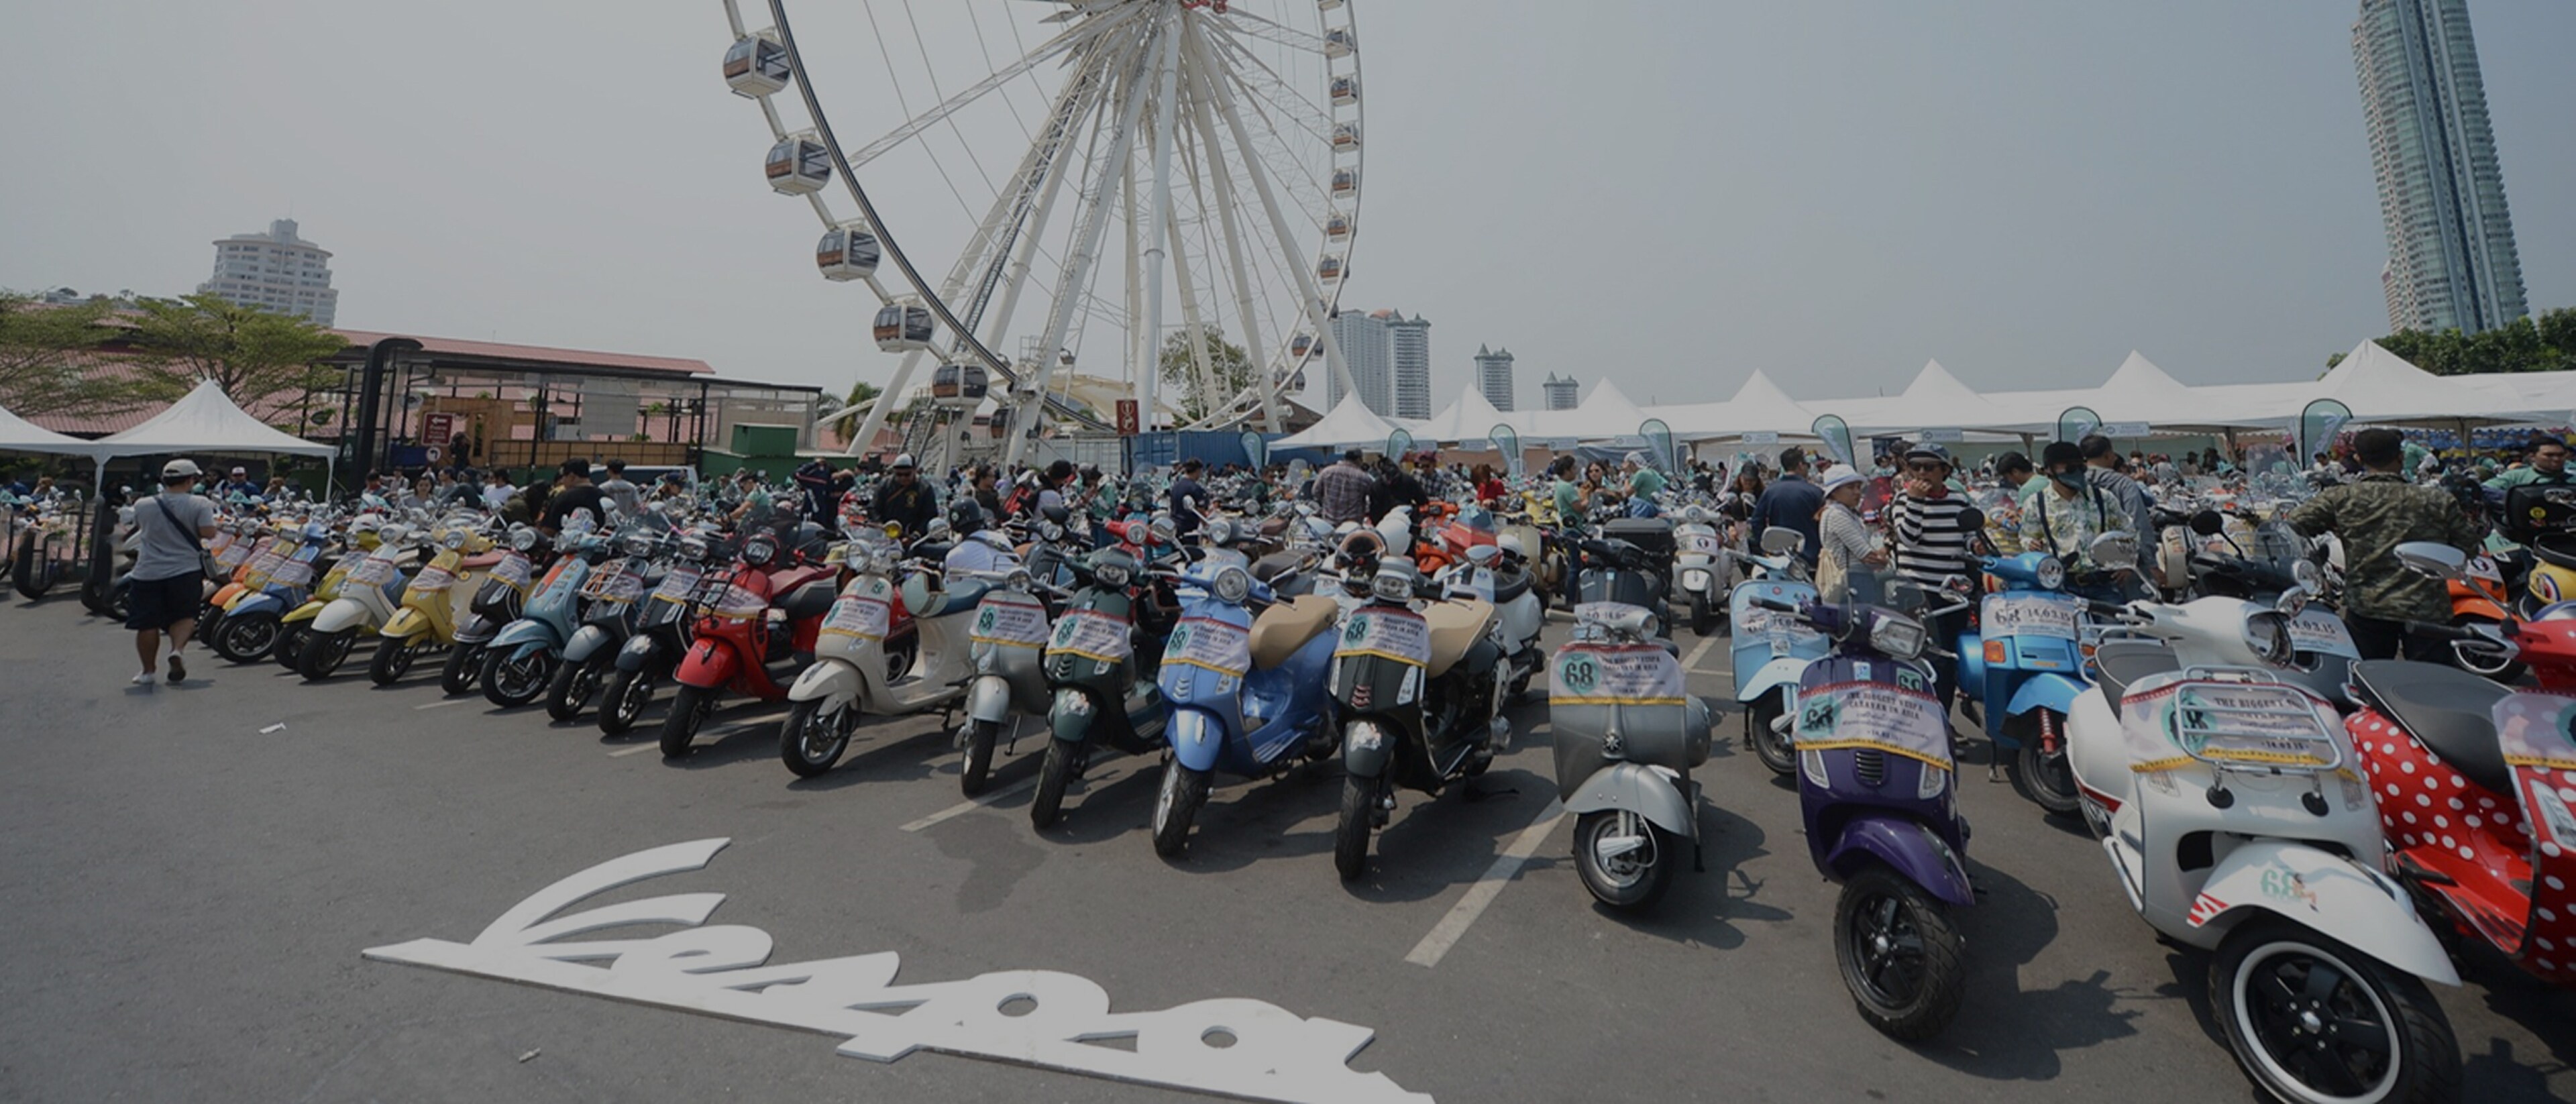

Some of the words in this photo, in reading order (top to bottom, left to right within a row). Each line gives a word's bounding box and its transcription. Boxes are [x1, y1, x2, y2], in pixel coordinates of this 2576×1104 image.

[1345, 620, 1366, 642] 68
[1564, 661, 1594, 688] 68
[2214, 697, 2235, 707] THE
[2238, 698, 2282, 708] BIGGEST
[2261, 869, 2301, 901] 68
[362, 836, 1436, 1104] Vespa
